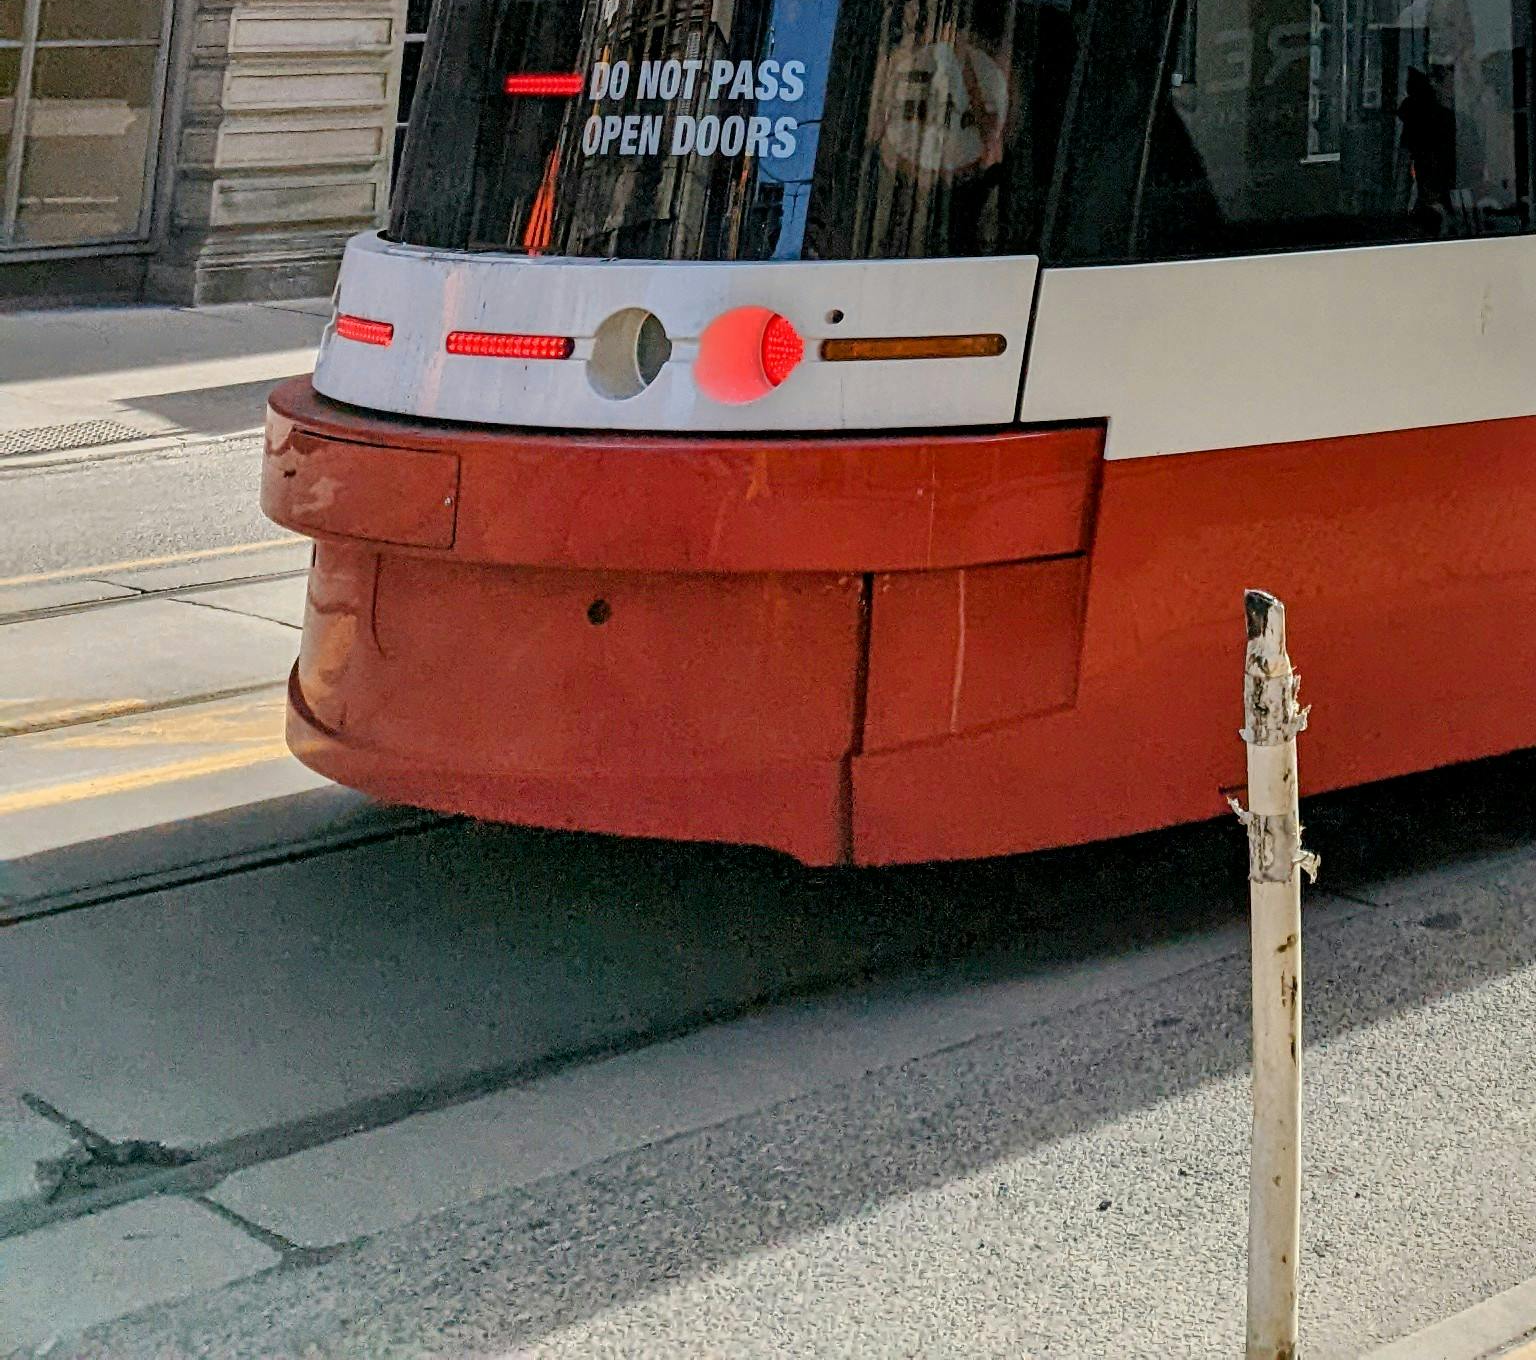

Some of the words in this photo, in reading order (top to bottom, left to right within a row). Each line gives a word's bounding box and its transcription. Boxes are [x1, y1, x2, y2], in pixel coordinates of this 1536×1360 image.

[589, 60, 630, 101] DO
[637, 60, 702, 100] NOT
[709, 59, 806, 102] PASS
[582, 115, 664, 157] OPEN
[671, 116, 798, 159] DOORS
